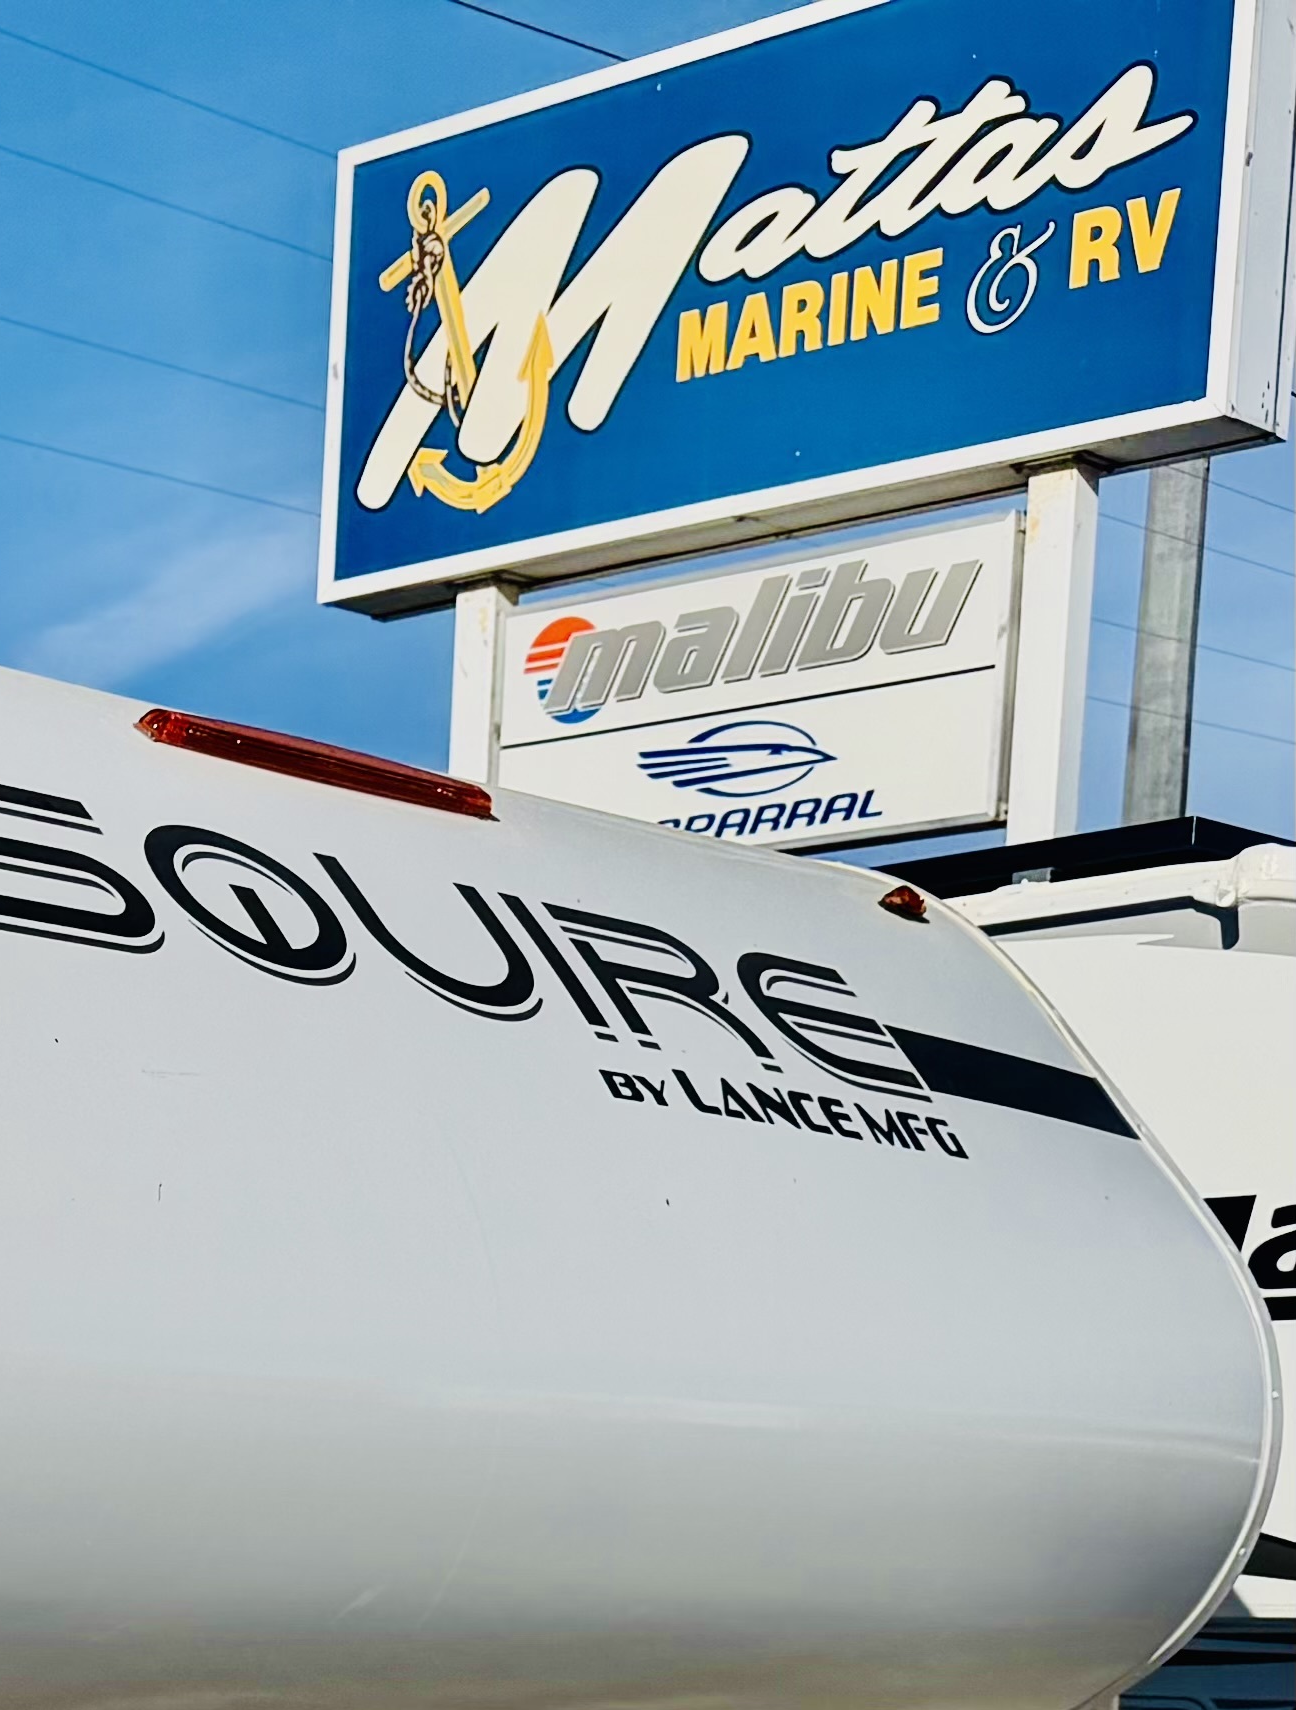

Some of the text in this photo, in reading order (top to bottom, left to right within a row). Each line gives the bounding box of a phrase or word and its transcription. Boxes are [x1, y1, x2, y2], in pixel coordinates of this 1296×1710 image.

[355, 60, 1196, 510] Mattas
[675, 187, 1184, 383] MARINE & RV
[544, 558, 984, 715] malibu
[598, 1068, 970, 1160] BY LANCE MFG
